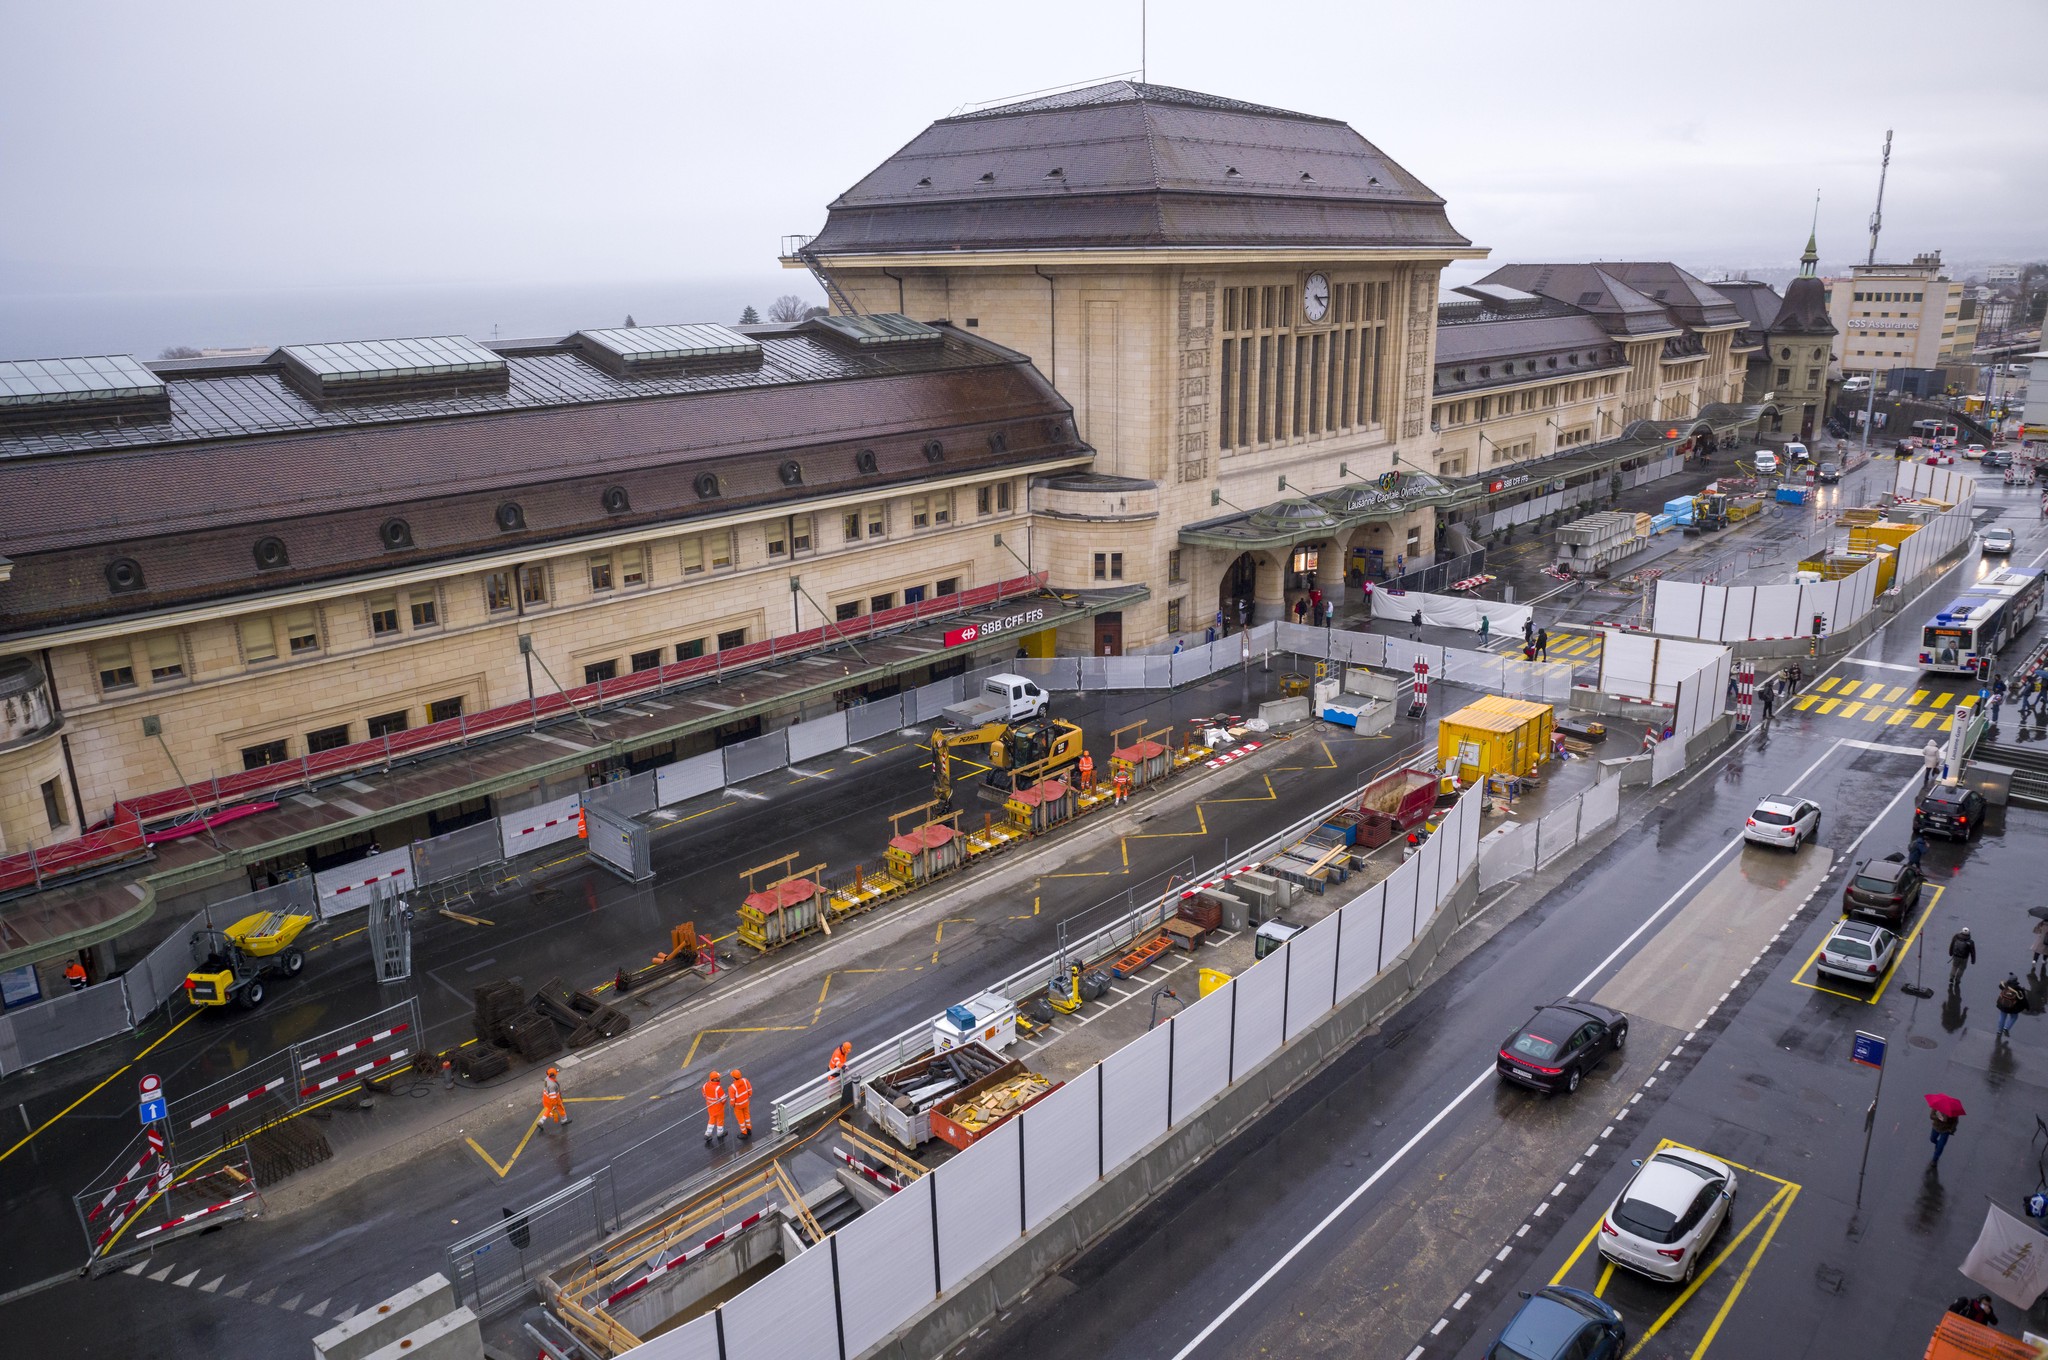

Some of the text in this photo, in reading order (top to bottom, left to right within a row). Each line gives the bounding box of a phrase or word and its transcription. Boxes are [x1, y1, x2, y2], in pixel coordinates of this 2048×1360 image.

[1847, 319, 1919, 330] CSS Assurance
[1347, 483, 1427, 511] Lausanne Capitale Olympique
[981, 608, 1043, 635] SBB CFF FFS
